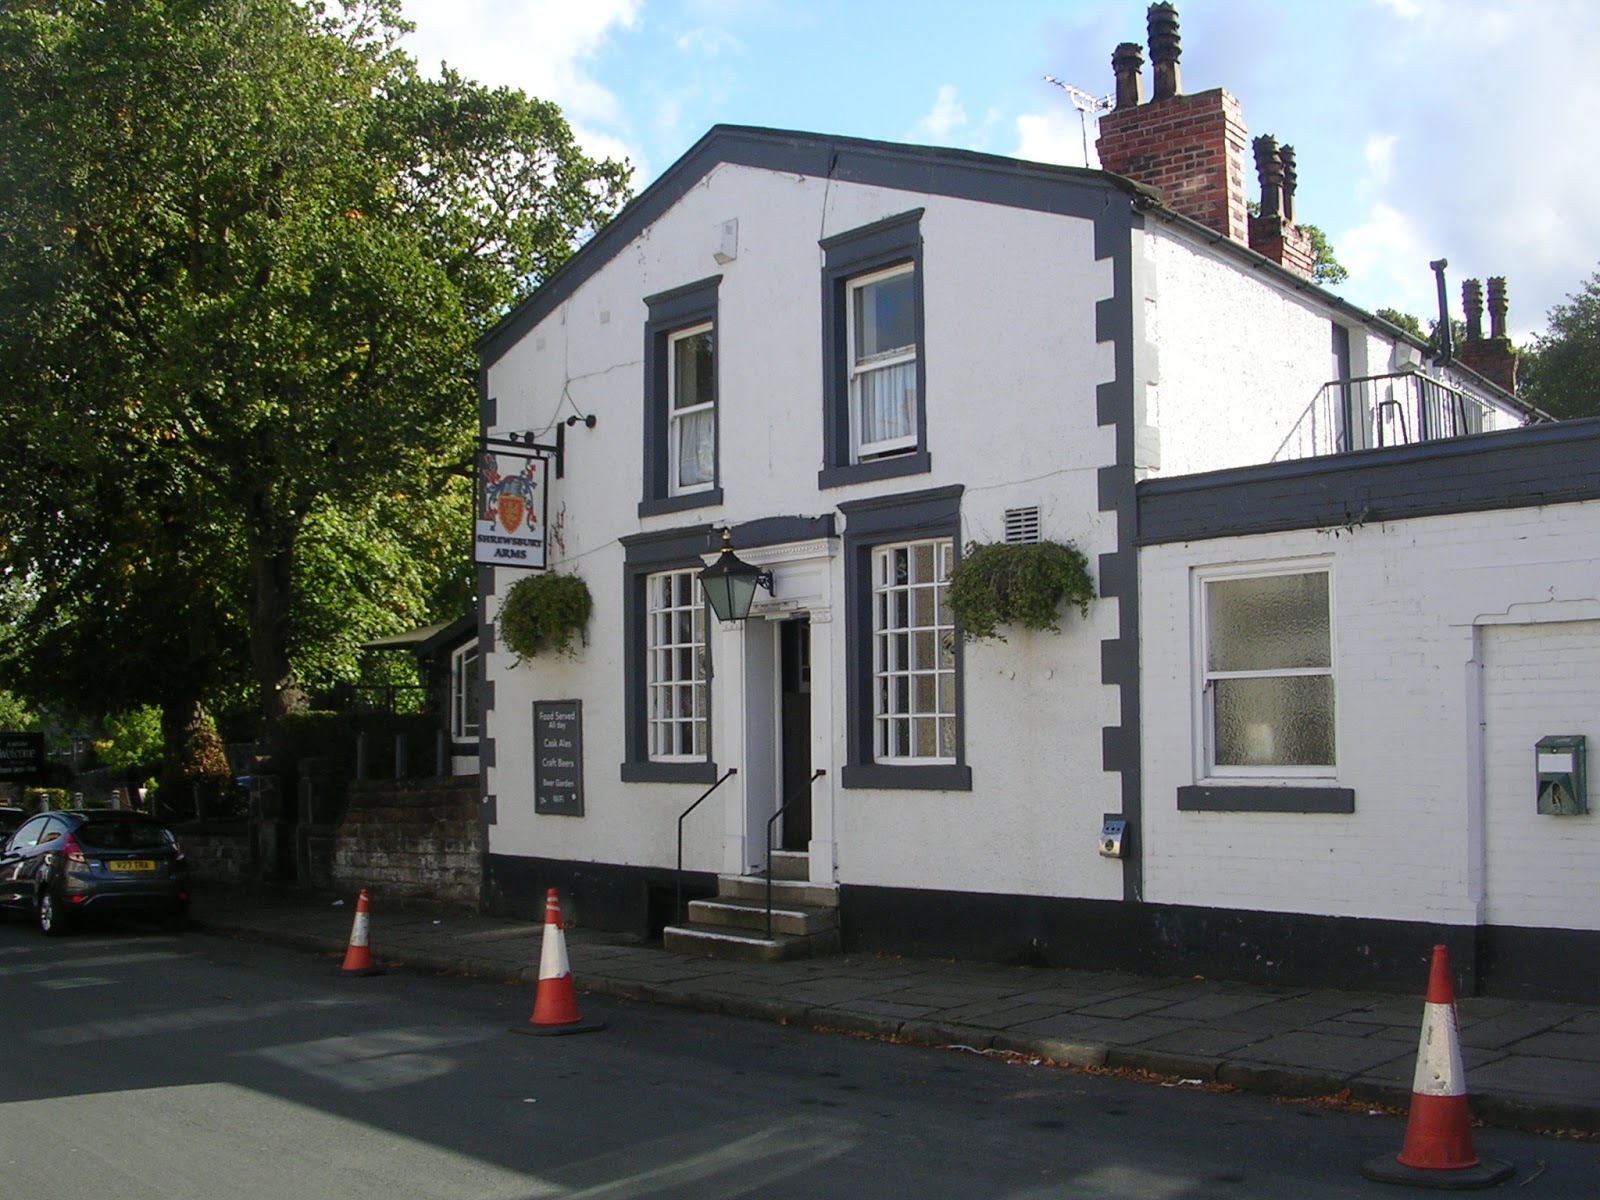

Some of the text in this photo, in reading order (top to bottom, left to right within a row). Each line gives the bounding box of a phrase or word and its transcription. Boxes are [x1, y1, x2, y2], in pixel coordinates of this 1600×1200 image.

[477, 534, 542, 548] SHREWSBURY
[494, 548, 527, 559] ARMS
[540, 711, 576, 720] Food Served
[557, 721, 566, 731] day
[544, 738, 572, 748] Cask Ales
[542, 757, 574, 768] Craft Beers
[543, 778, 575, 788] Beer Garden
